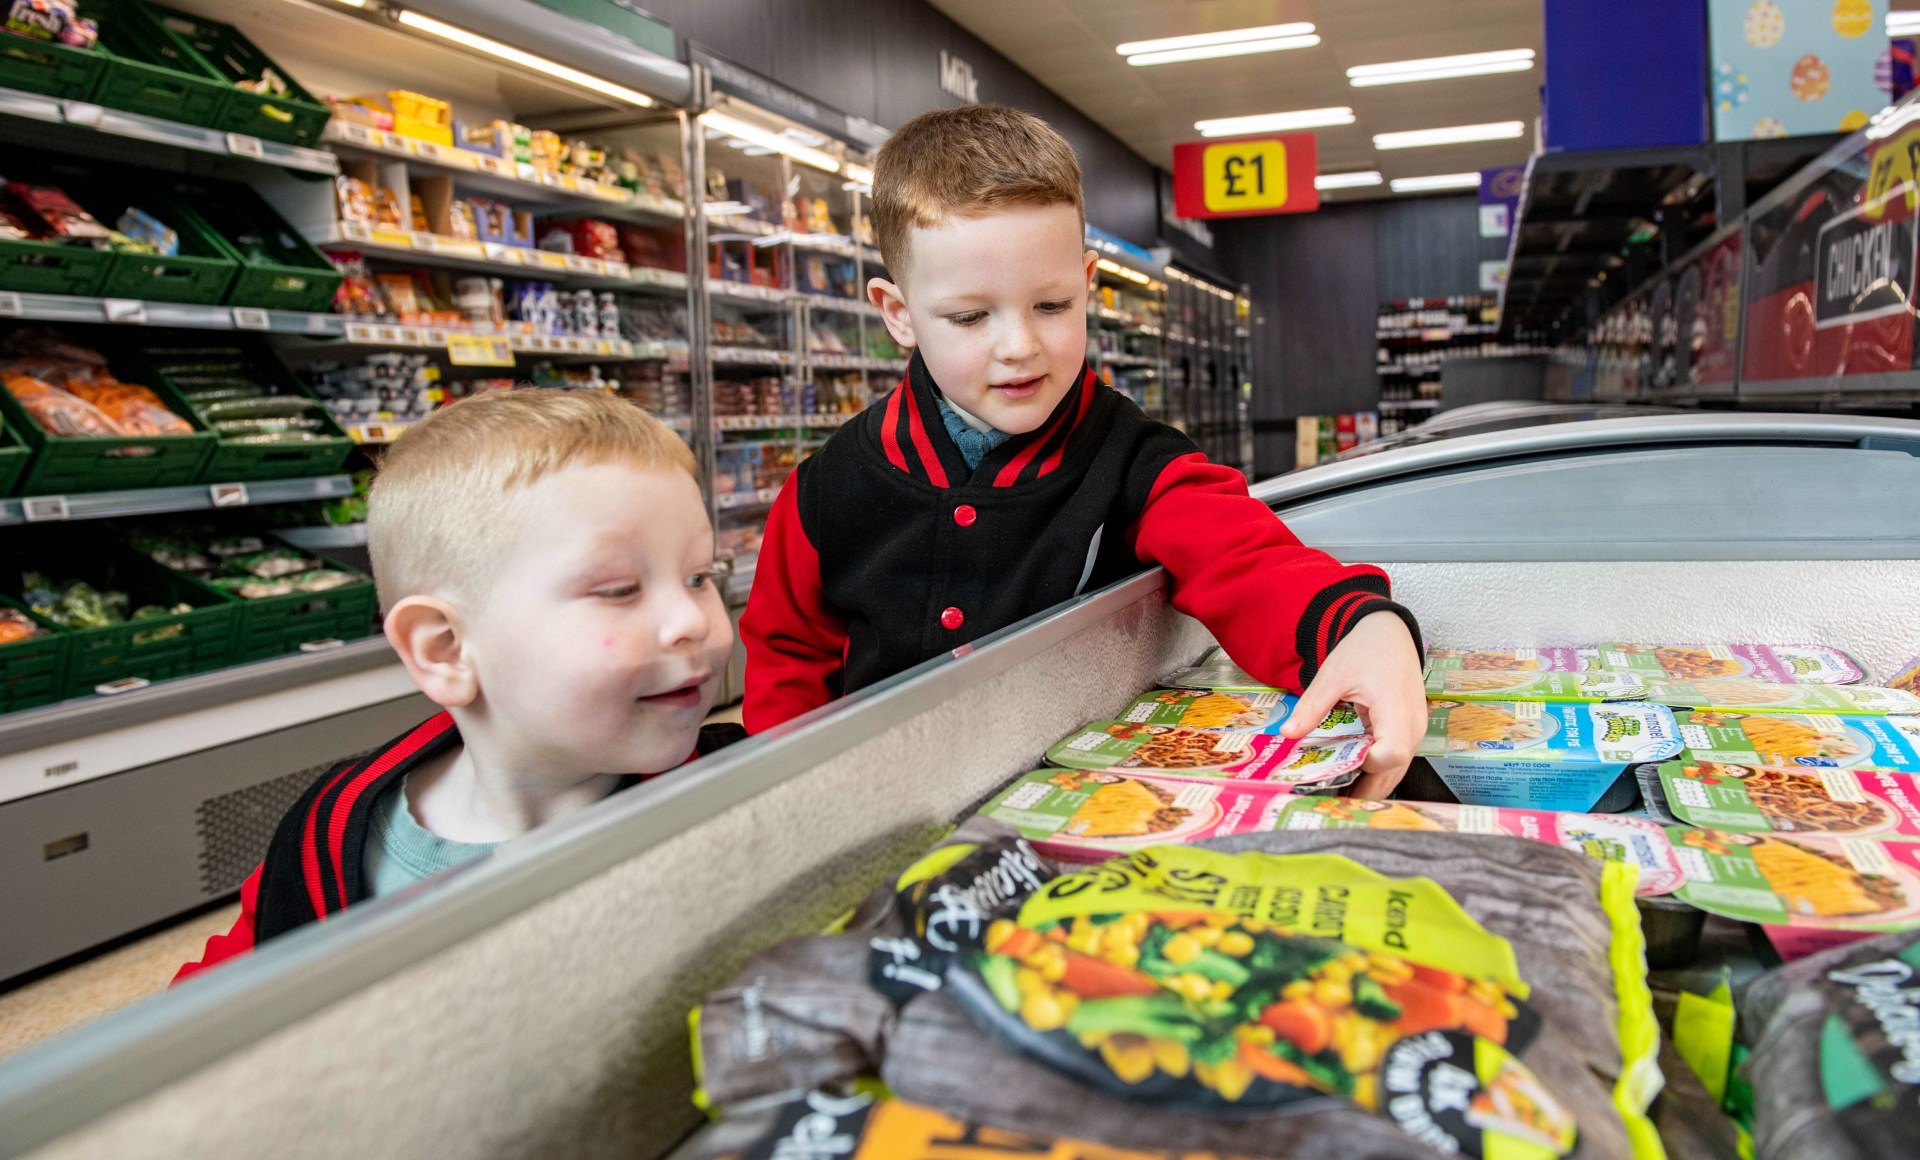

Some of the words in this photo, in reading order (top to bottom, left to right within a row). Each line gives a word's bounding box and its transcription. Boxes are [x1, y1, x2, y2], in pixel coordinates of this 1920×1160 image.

[938, 48, 979, 102] Milk
[1223, 154, 1266, 197] £1
[1826, 219, 1894, 302] CHICKEN
[1644, 713, 1666, 739] mumsnet
